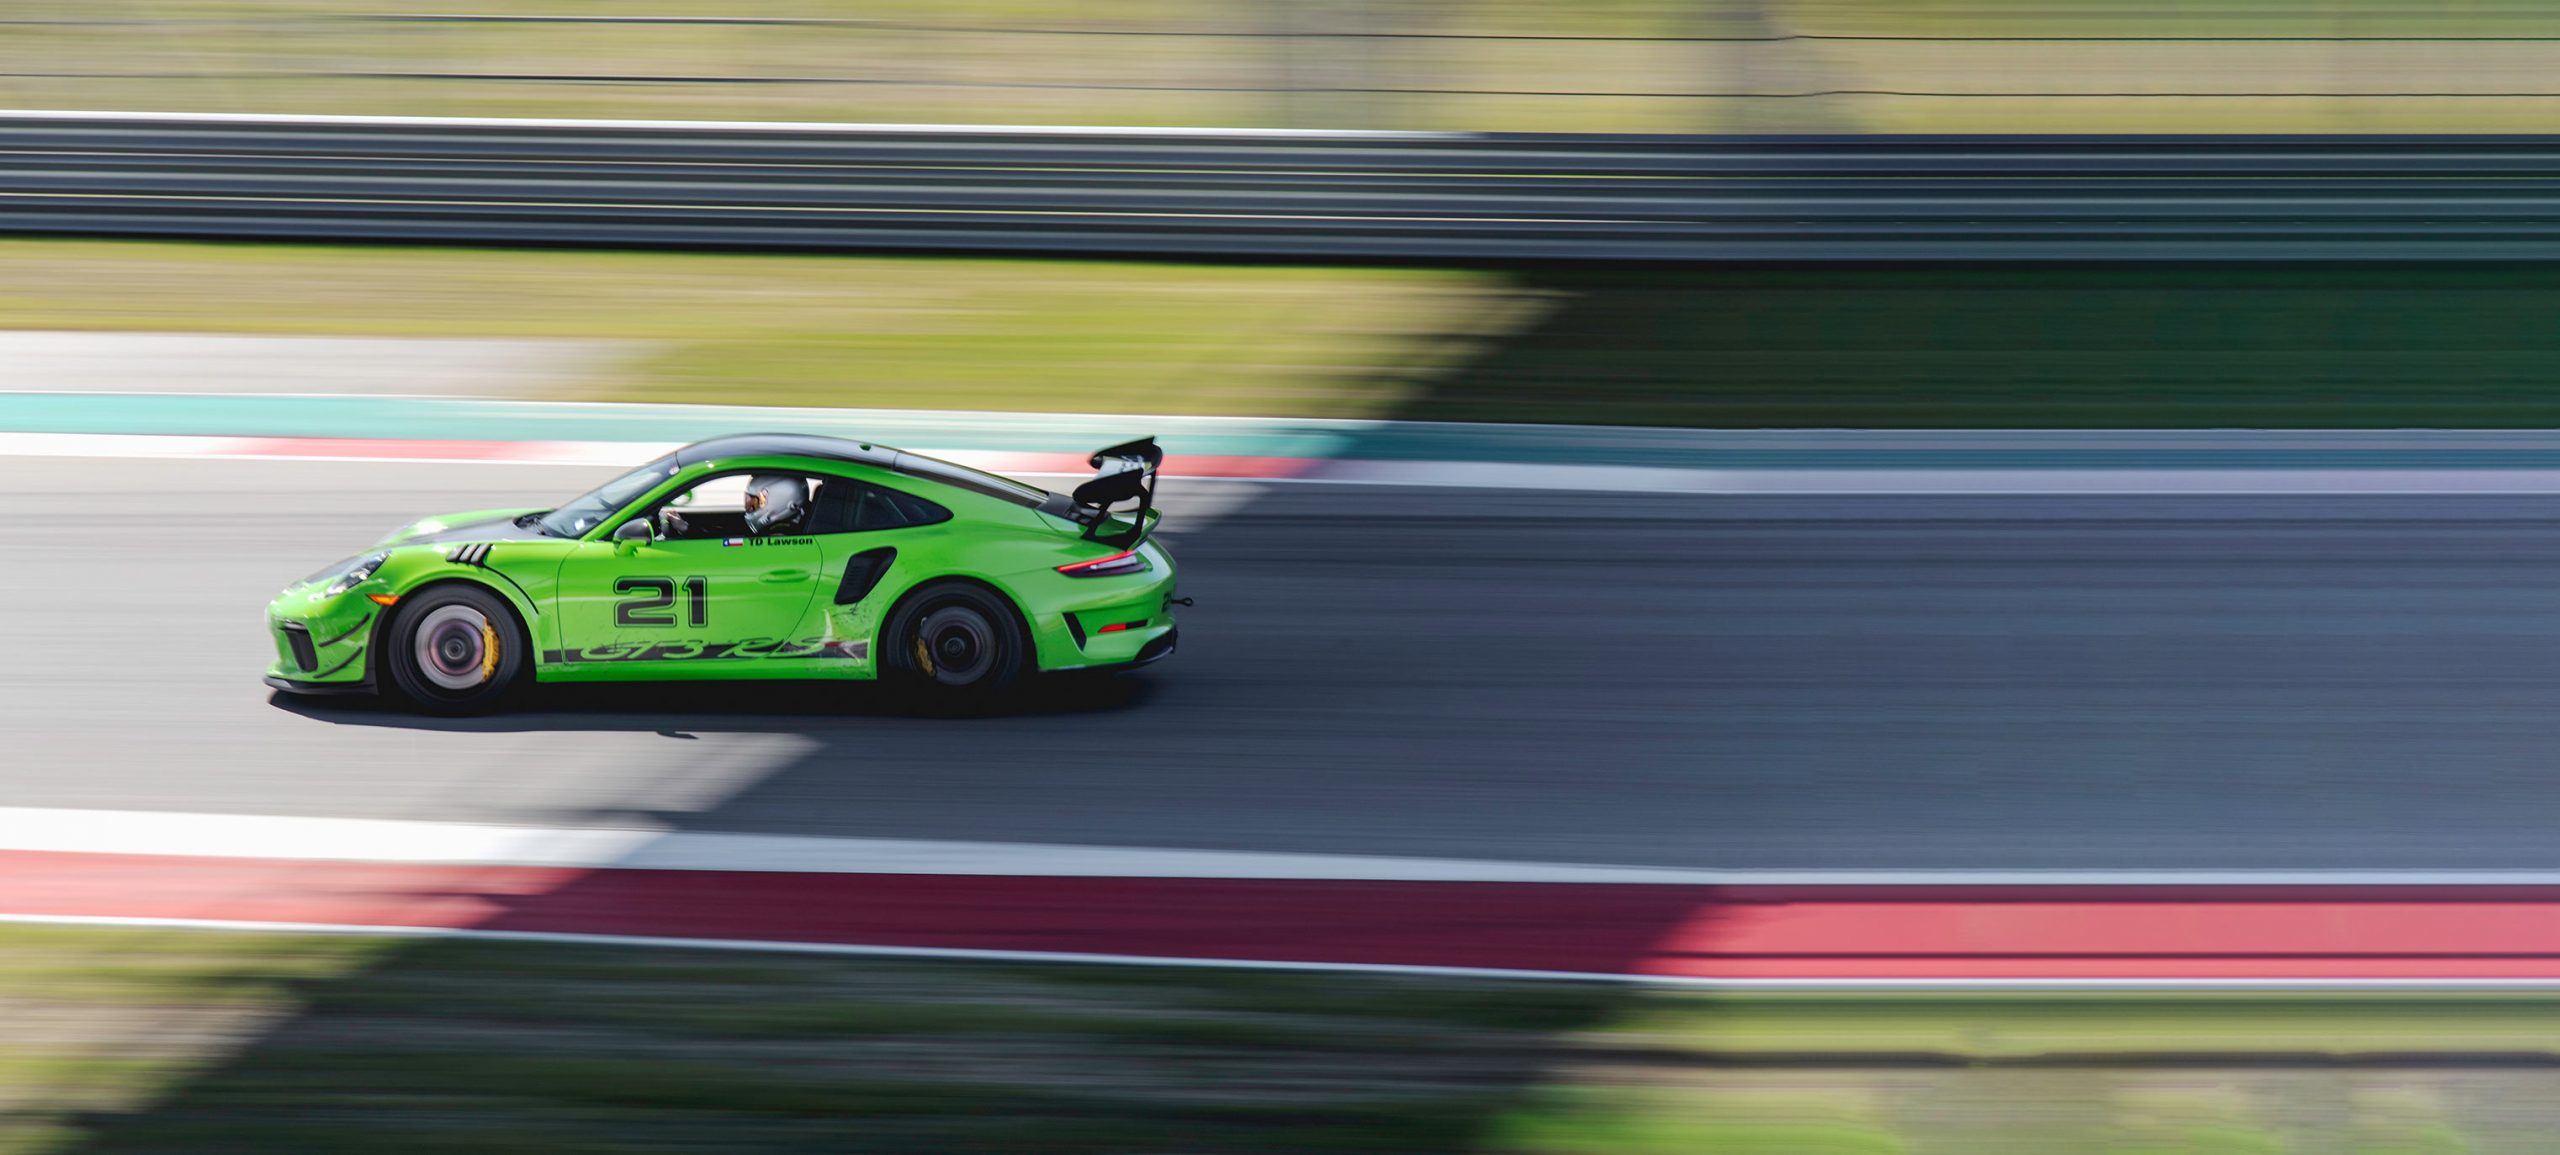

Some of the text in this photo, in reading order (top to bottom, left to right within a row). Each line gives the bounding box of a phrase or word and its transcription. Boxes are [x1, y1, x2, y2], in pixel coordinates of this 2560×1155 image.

[768, 537, 813, 546] Lawson
[613, 575, 708, 628] 21
[580, 639, 705, 661] GT3
